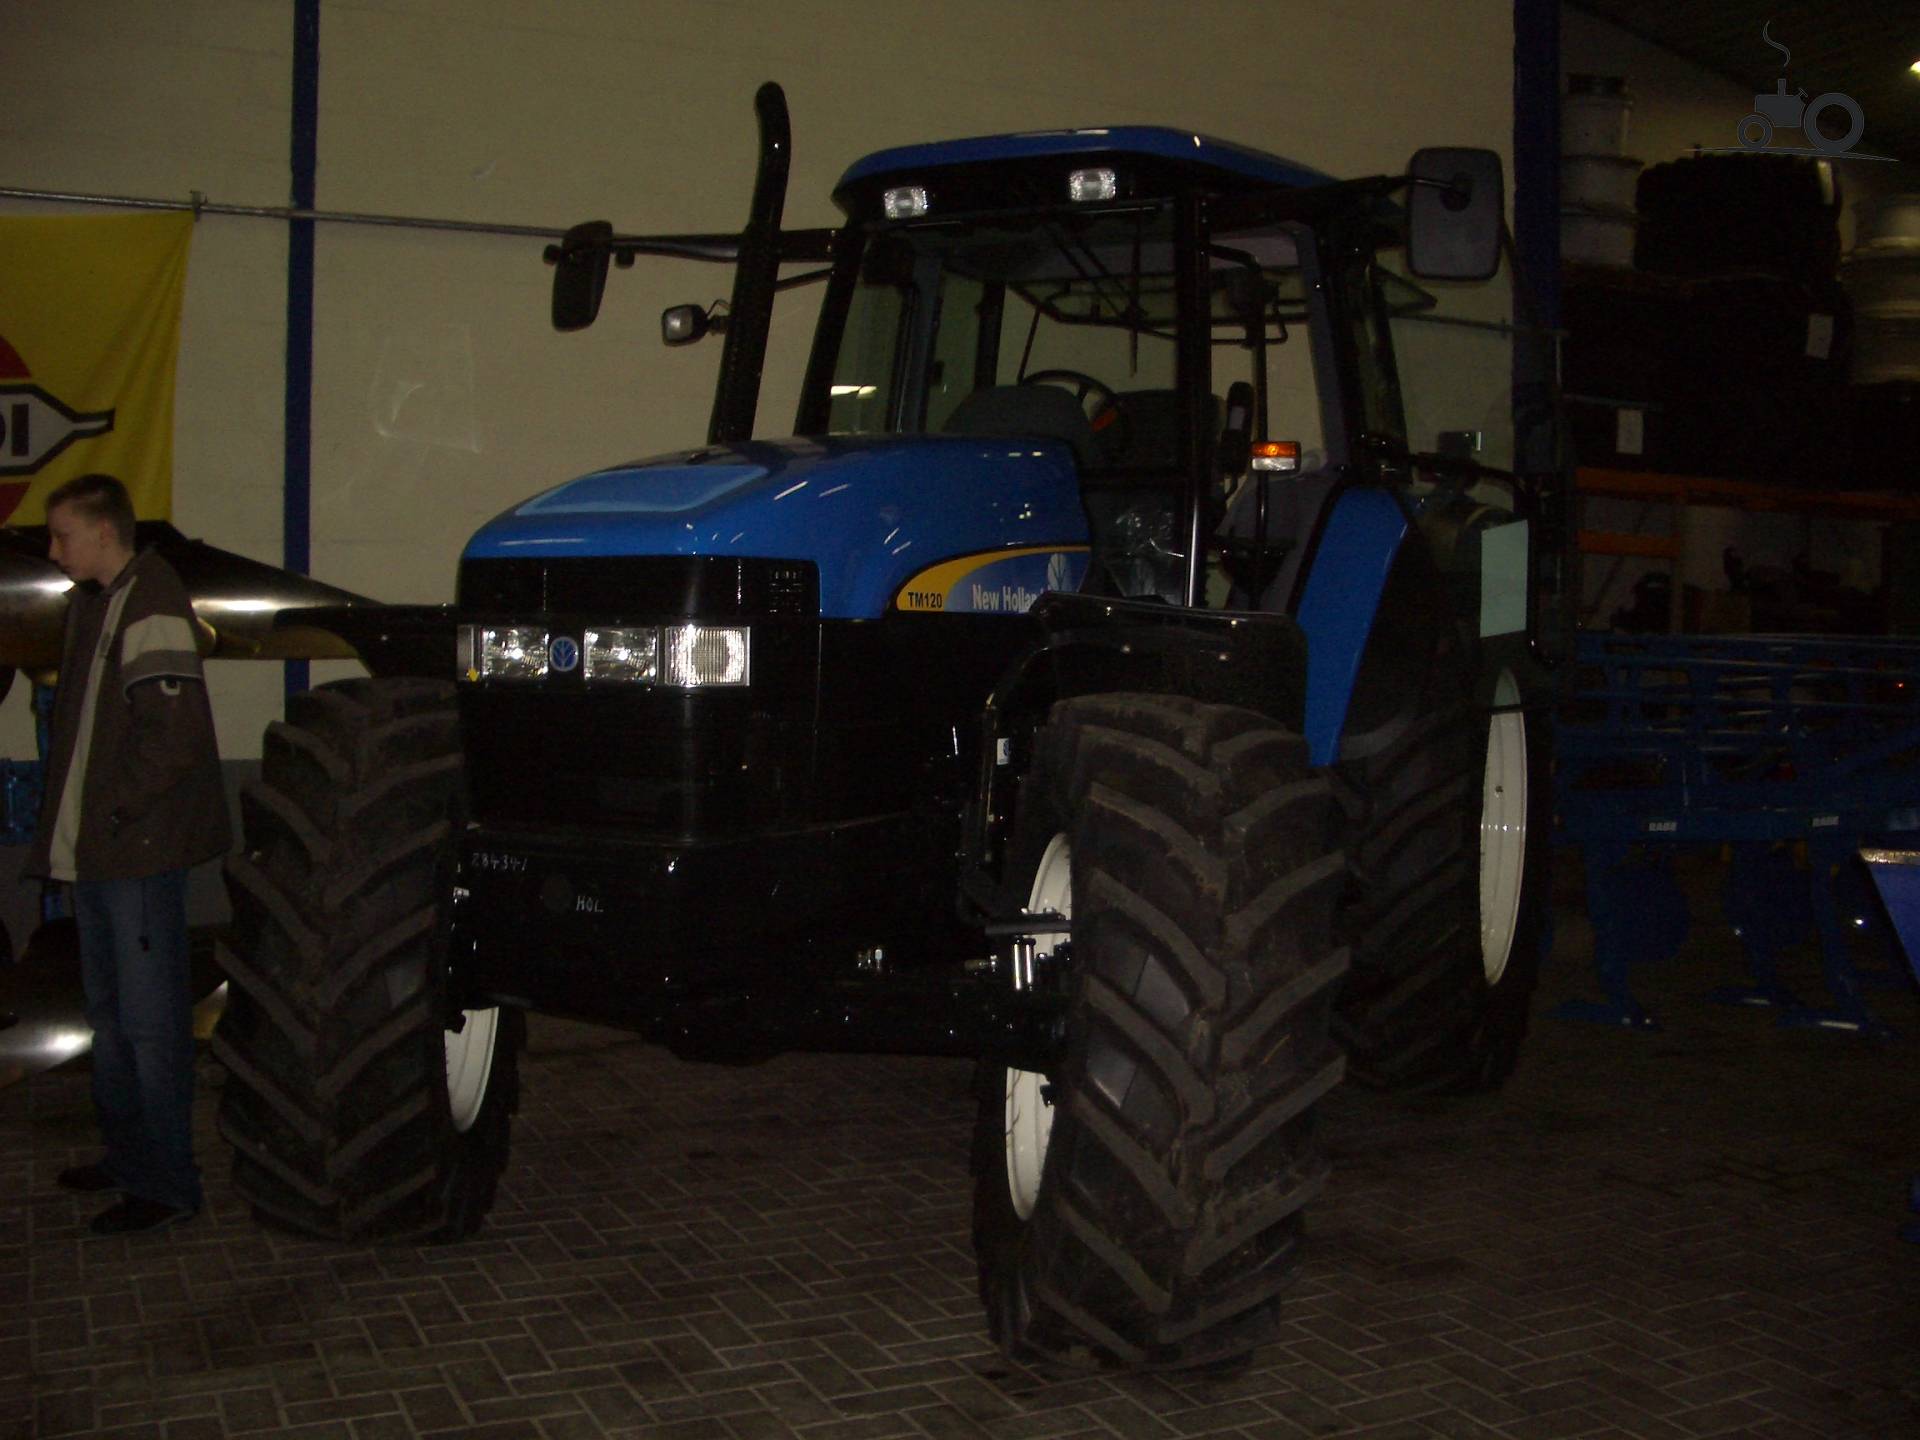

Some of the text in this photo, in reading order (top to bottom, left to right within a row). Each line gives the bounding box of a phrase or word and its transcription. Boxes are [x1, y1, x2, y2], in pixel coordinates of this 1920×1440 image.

[907, 591, 943, 609] TM120
[972, 584, 1044, 613] New Holla
